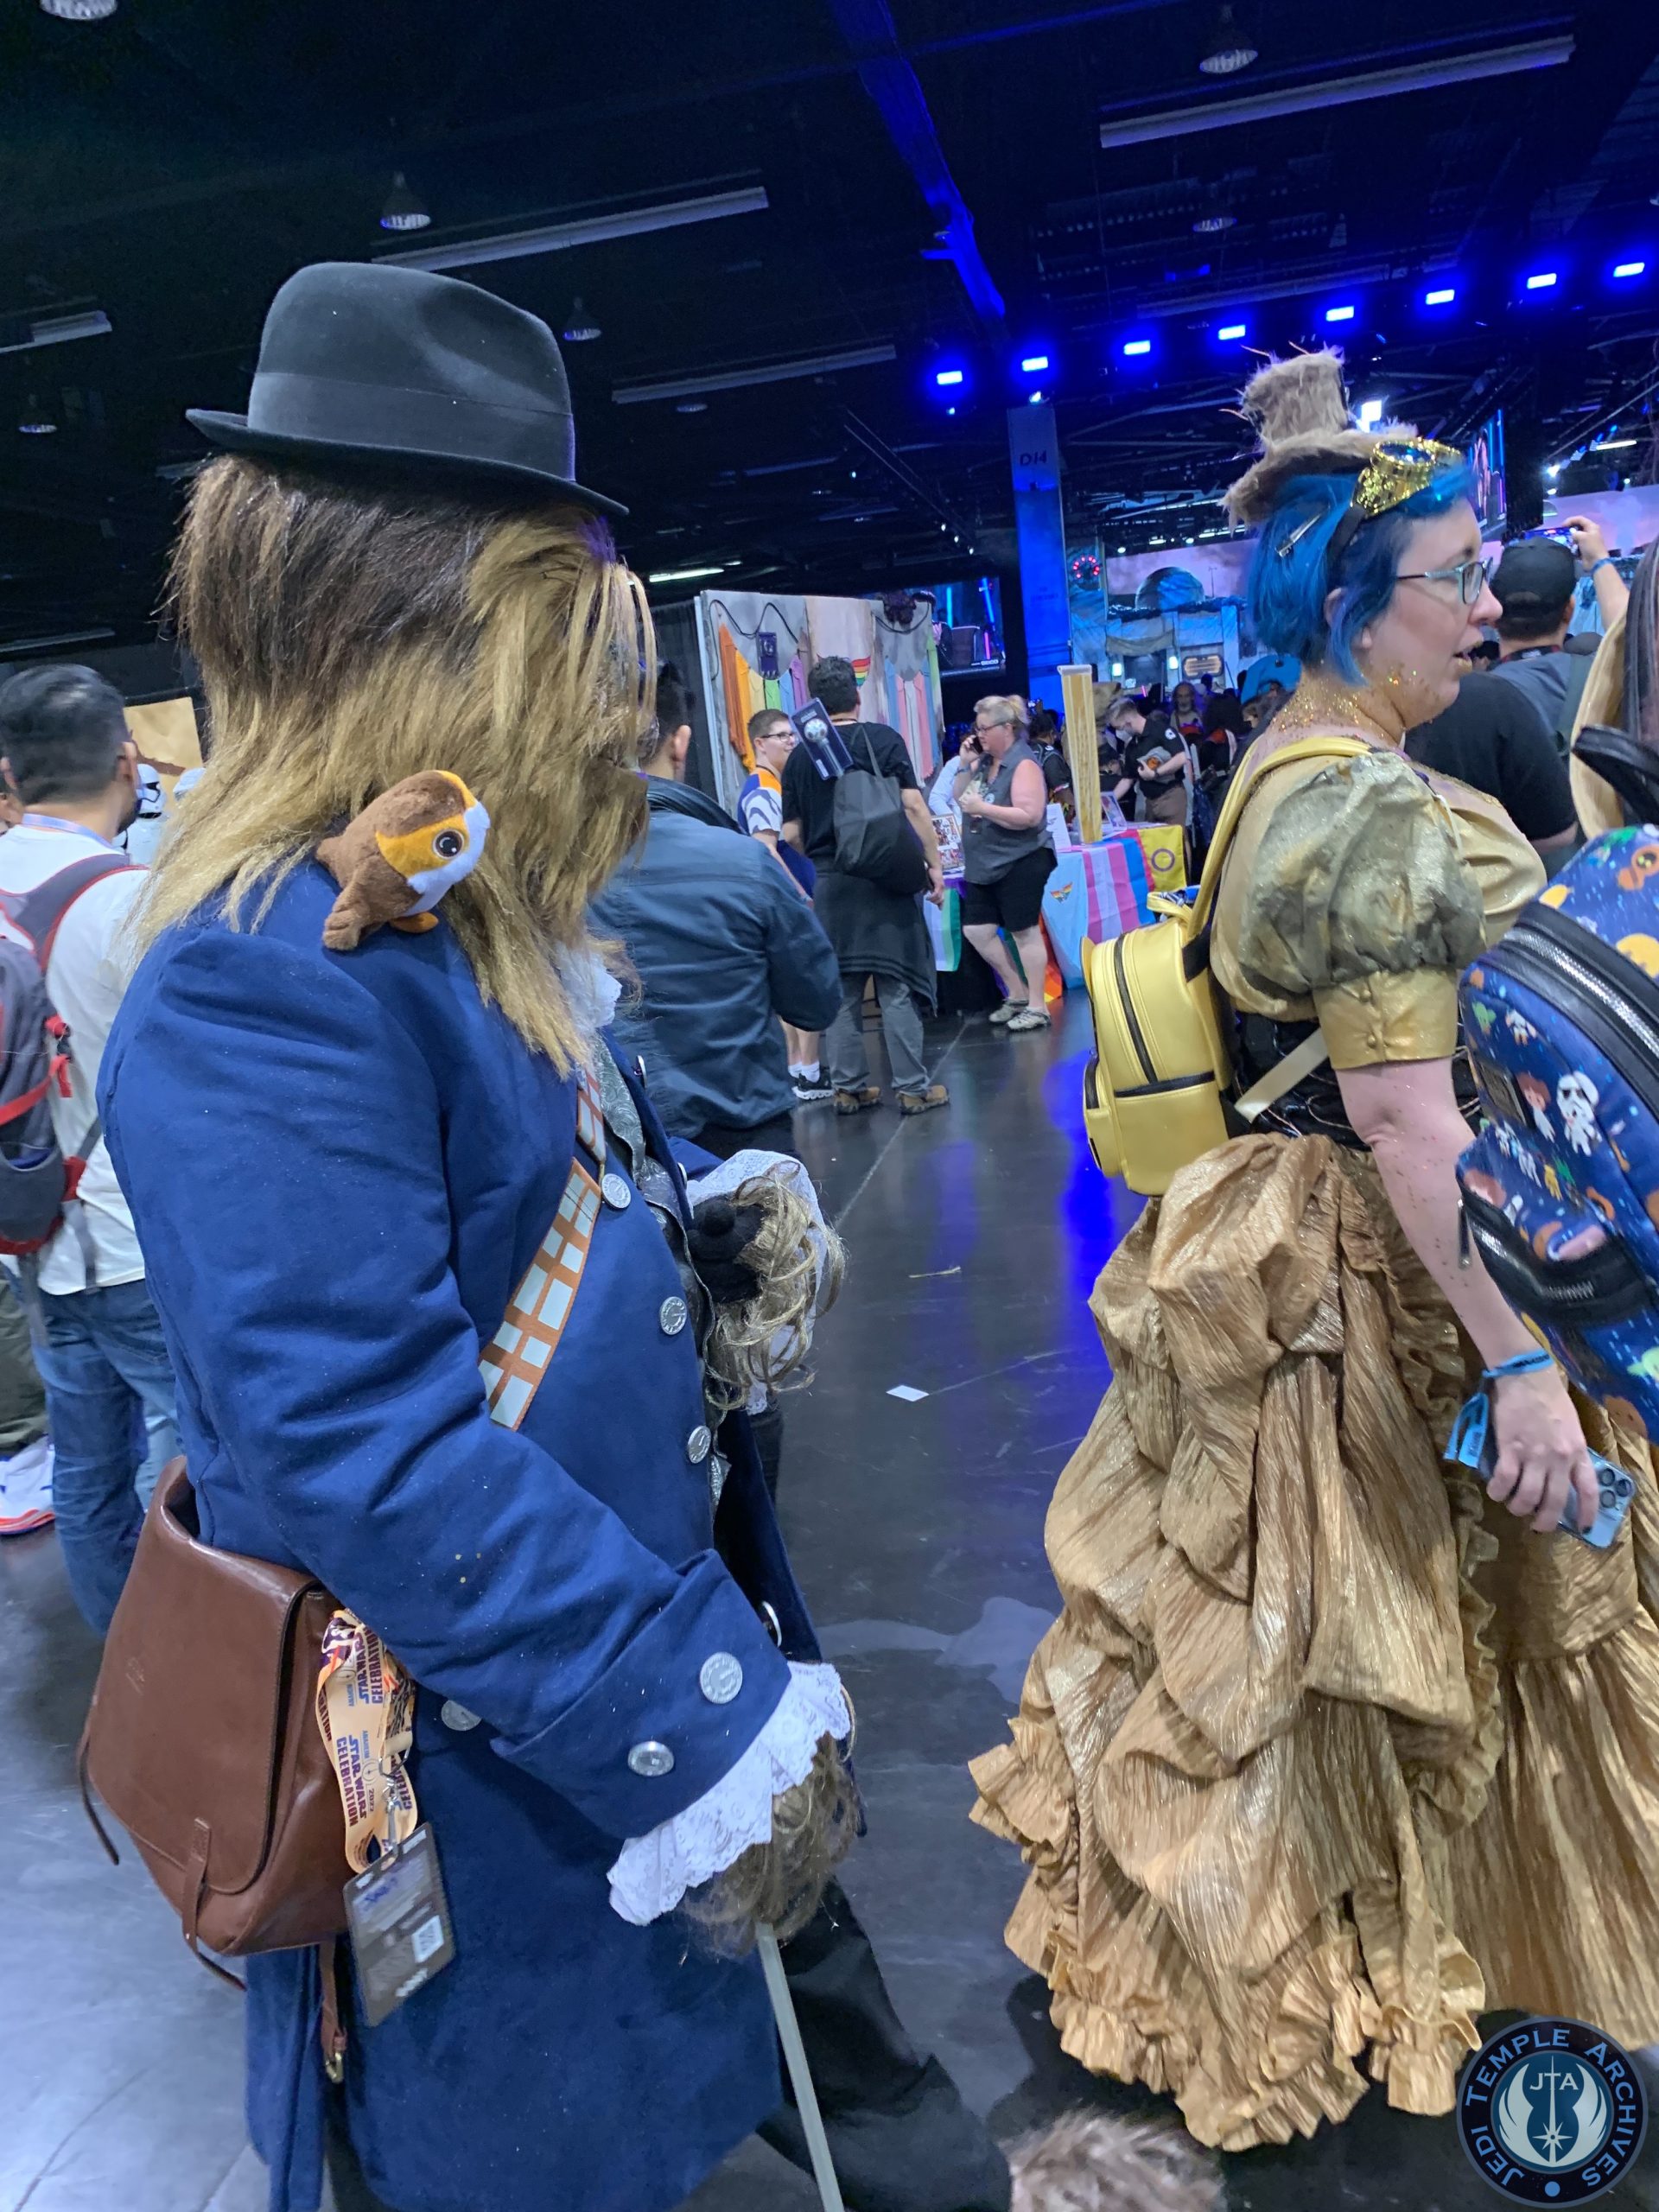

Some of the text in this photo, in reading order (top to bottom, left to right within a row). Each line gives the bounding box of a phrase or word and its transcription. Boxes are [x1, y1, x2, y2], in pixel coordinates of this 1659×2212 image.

[358, 1670, 370, 1705] STAR
[363, 1626, 384, 1705] CELEBRATION
[348, 1734, 361, 1778] STAR
[336, 1736, 359, 1827] CELEBRATION
[354, 1776, 367, 1819] WARS
